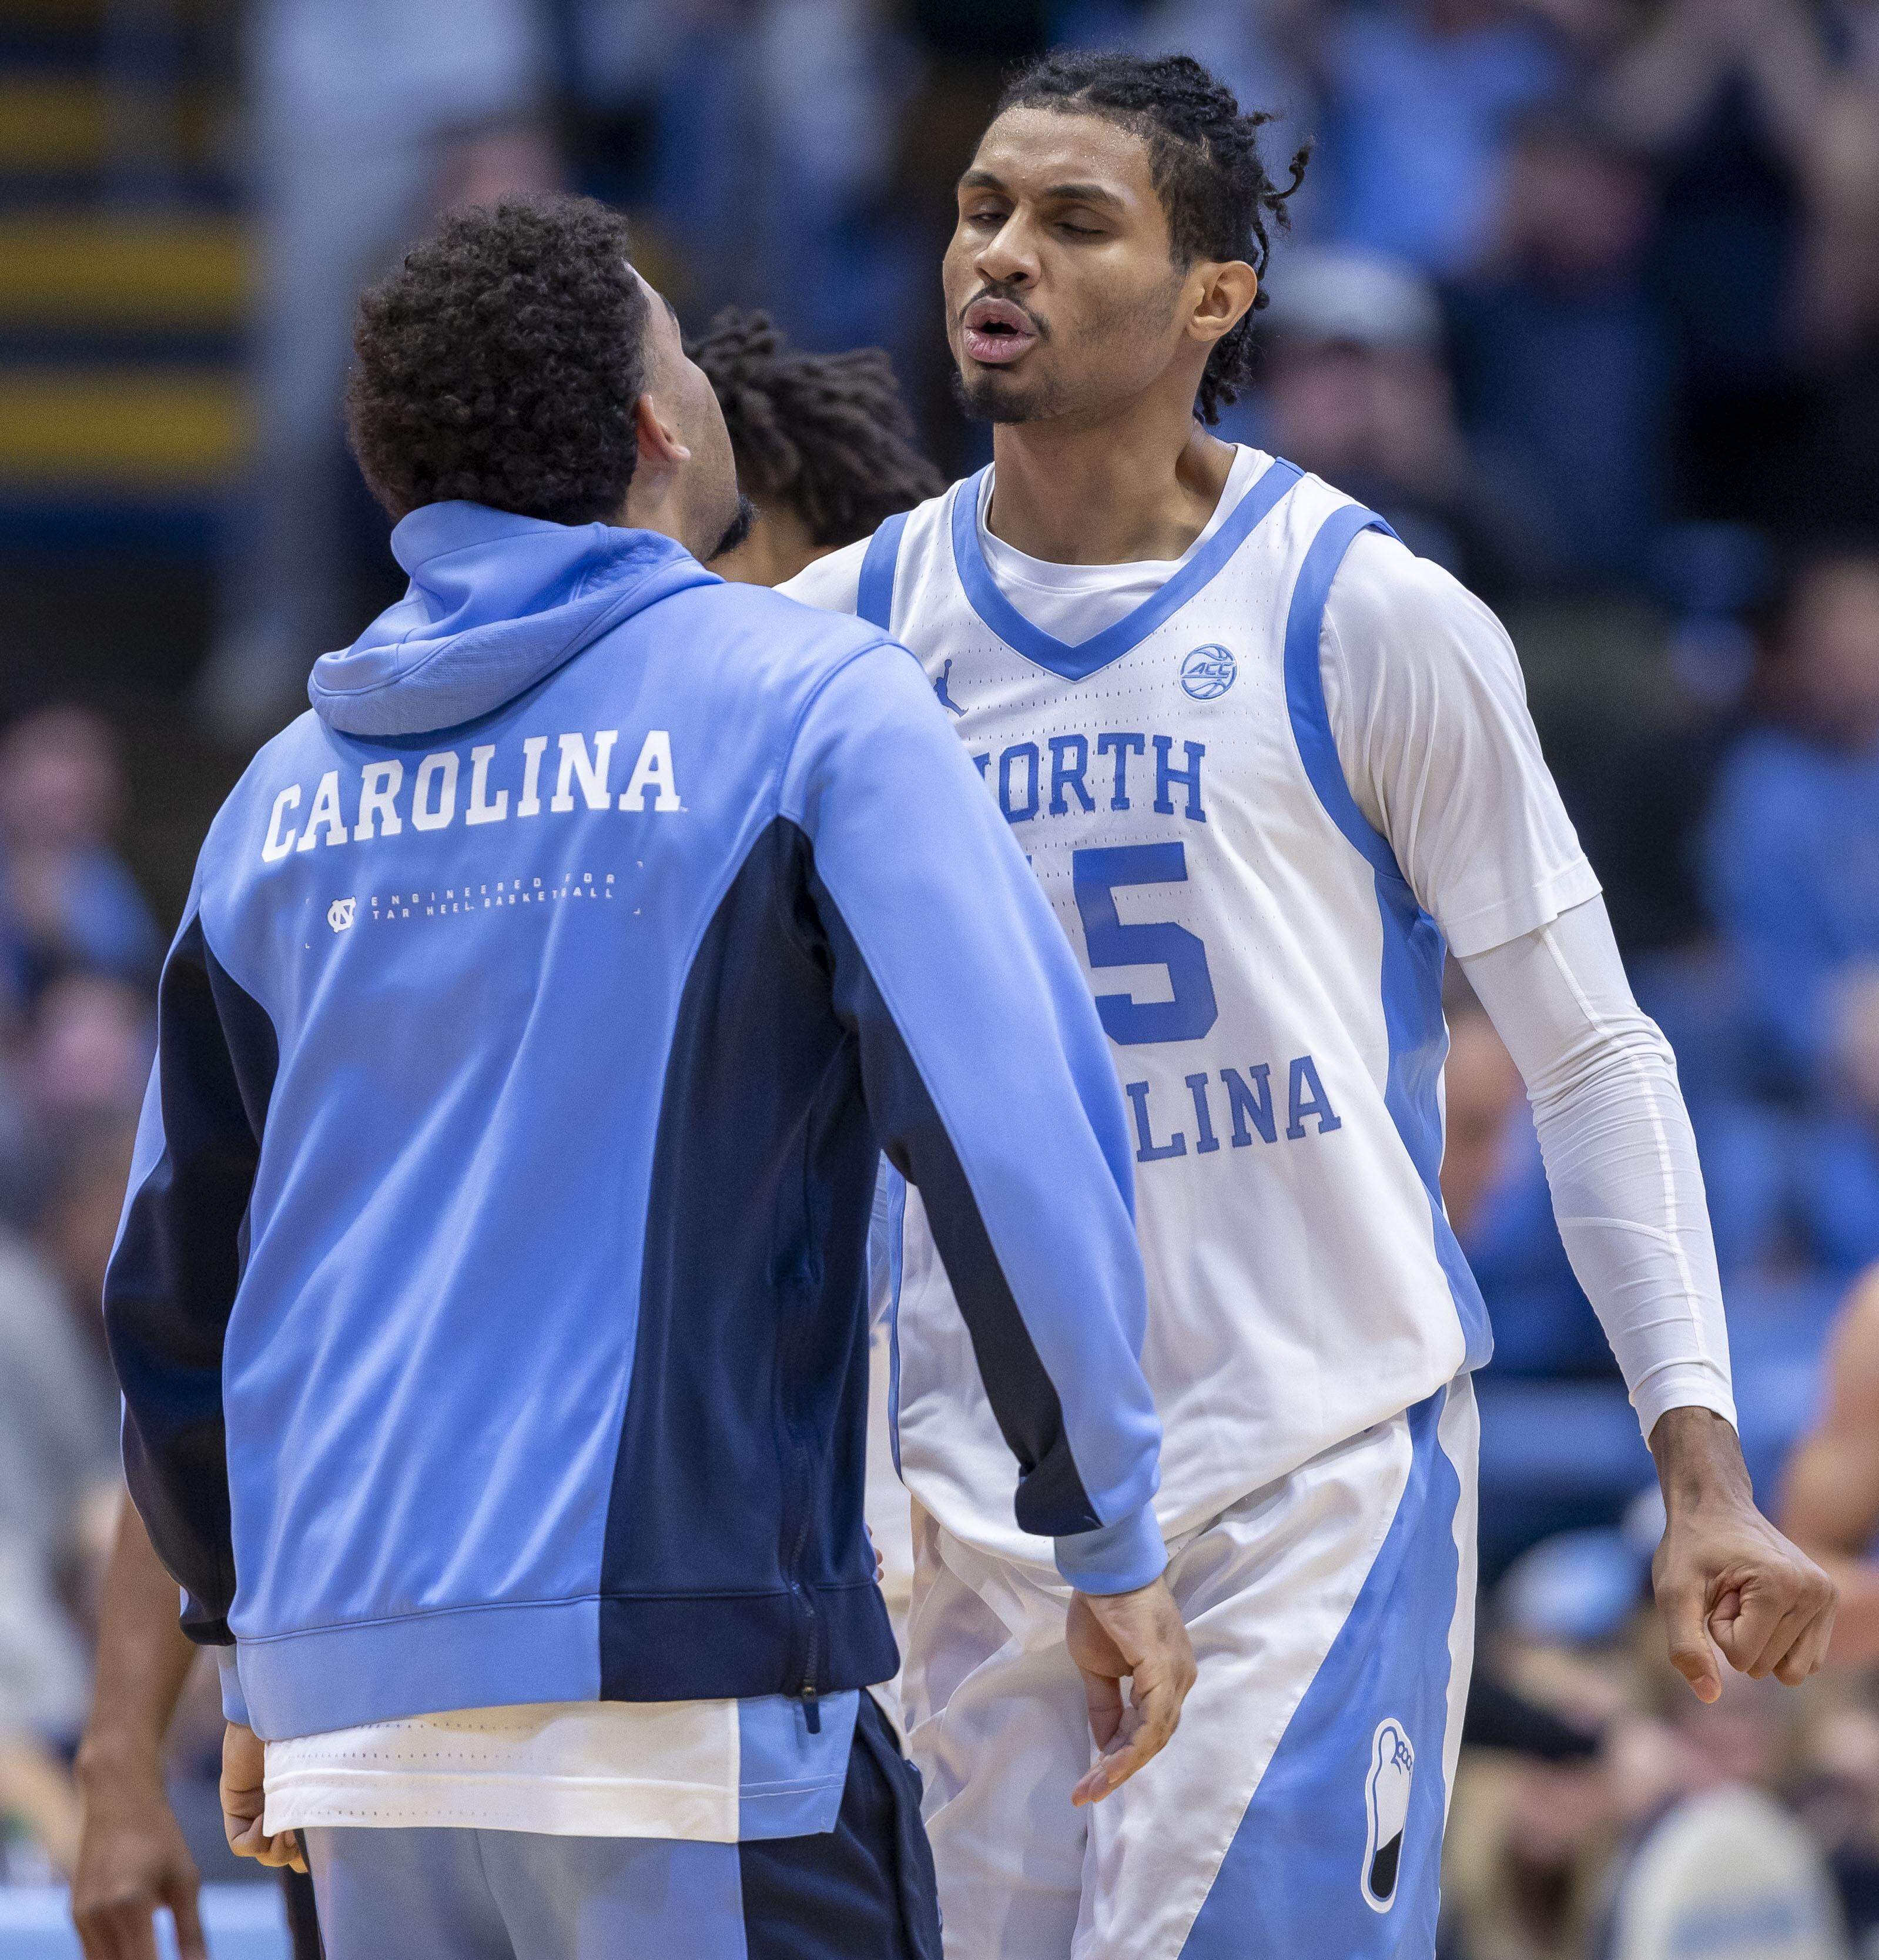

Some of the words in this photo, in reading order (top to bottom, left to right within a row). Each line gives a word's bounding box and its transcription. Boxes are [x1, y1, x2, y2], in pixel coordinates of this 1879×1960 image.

[1187, 662, 1234, 675] ACC
[262, 730, 681, 862] CAROLINA
[371, 878, 541, 906] ENGINEERED
[565, 872, 614, 884] FOR
[374, 908, 409, 919] TAR
[427, 901, 474, 916] HEEL
[484, 887, 612, 907] BASKETBALL
[1026, 842, 1218, 1046] 5
[1126, 1055, 1341, 1162] LINA
